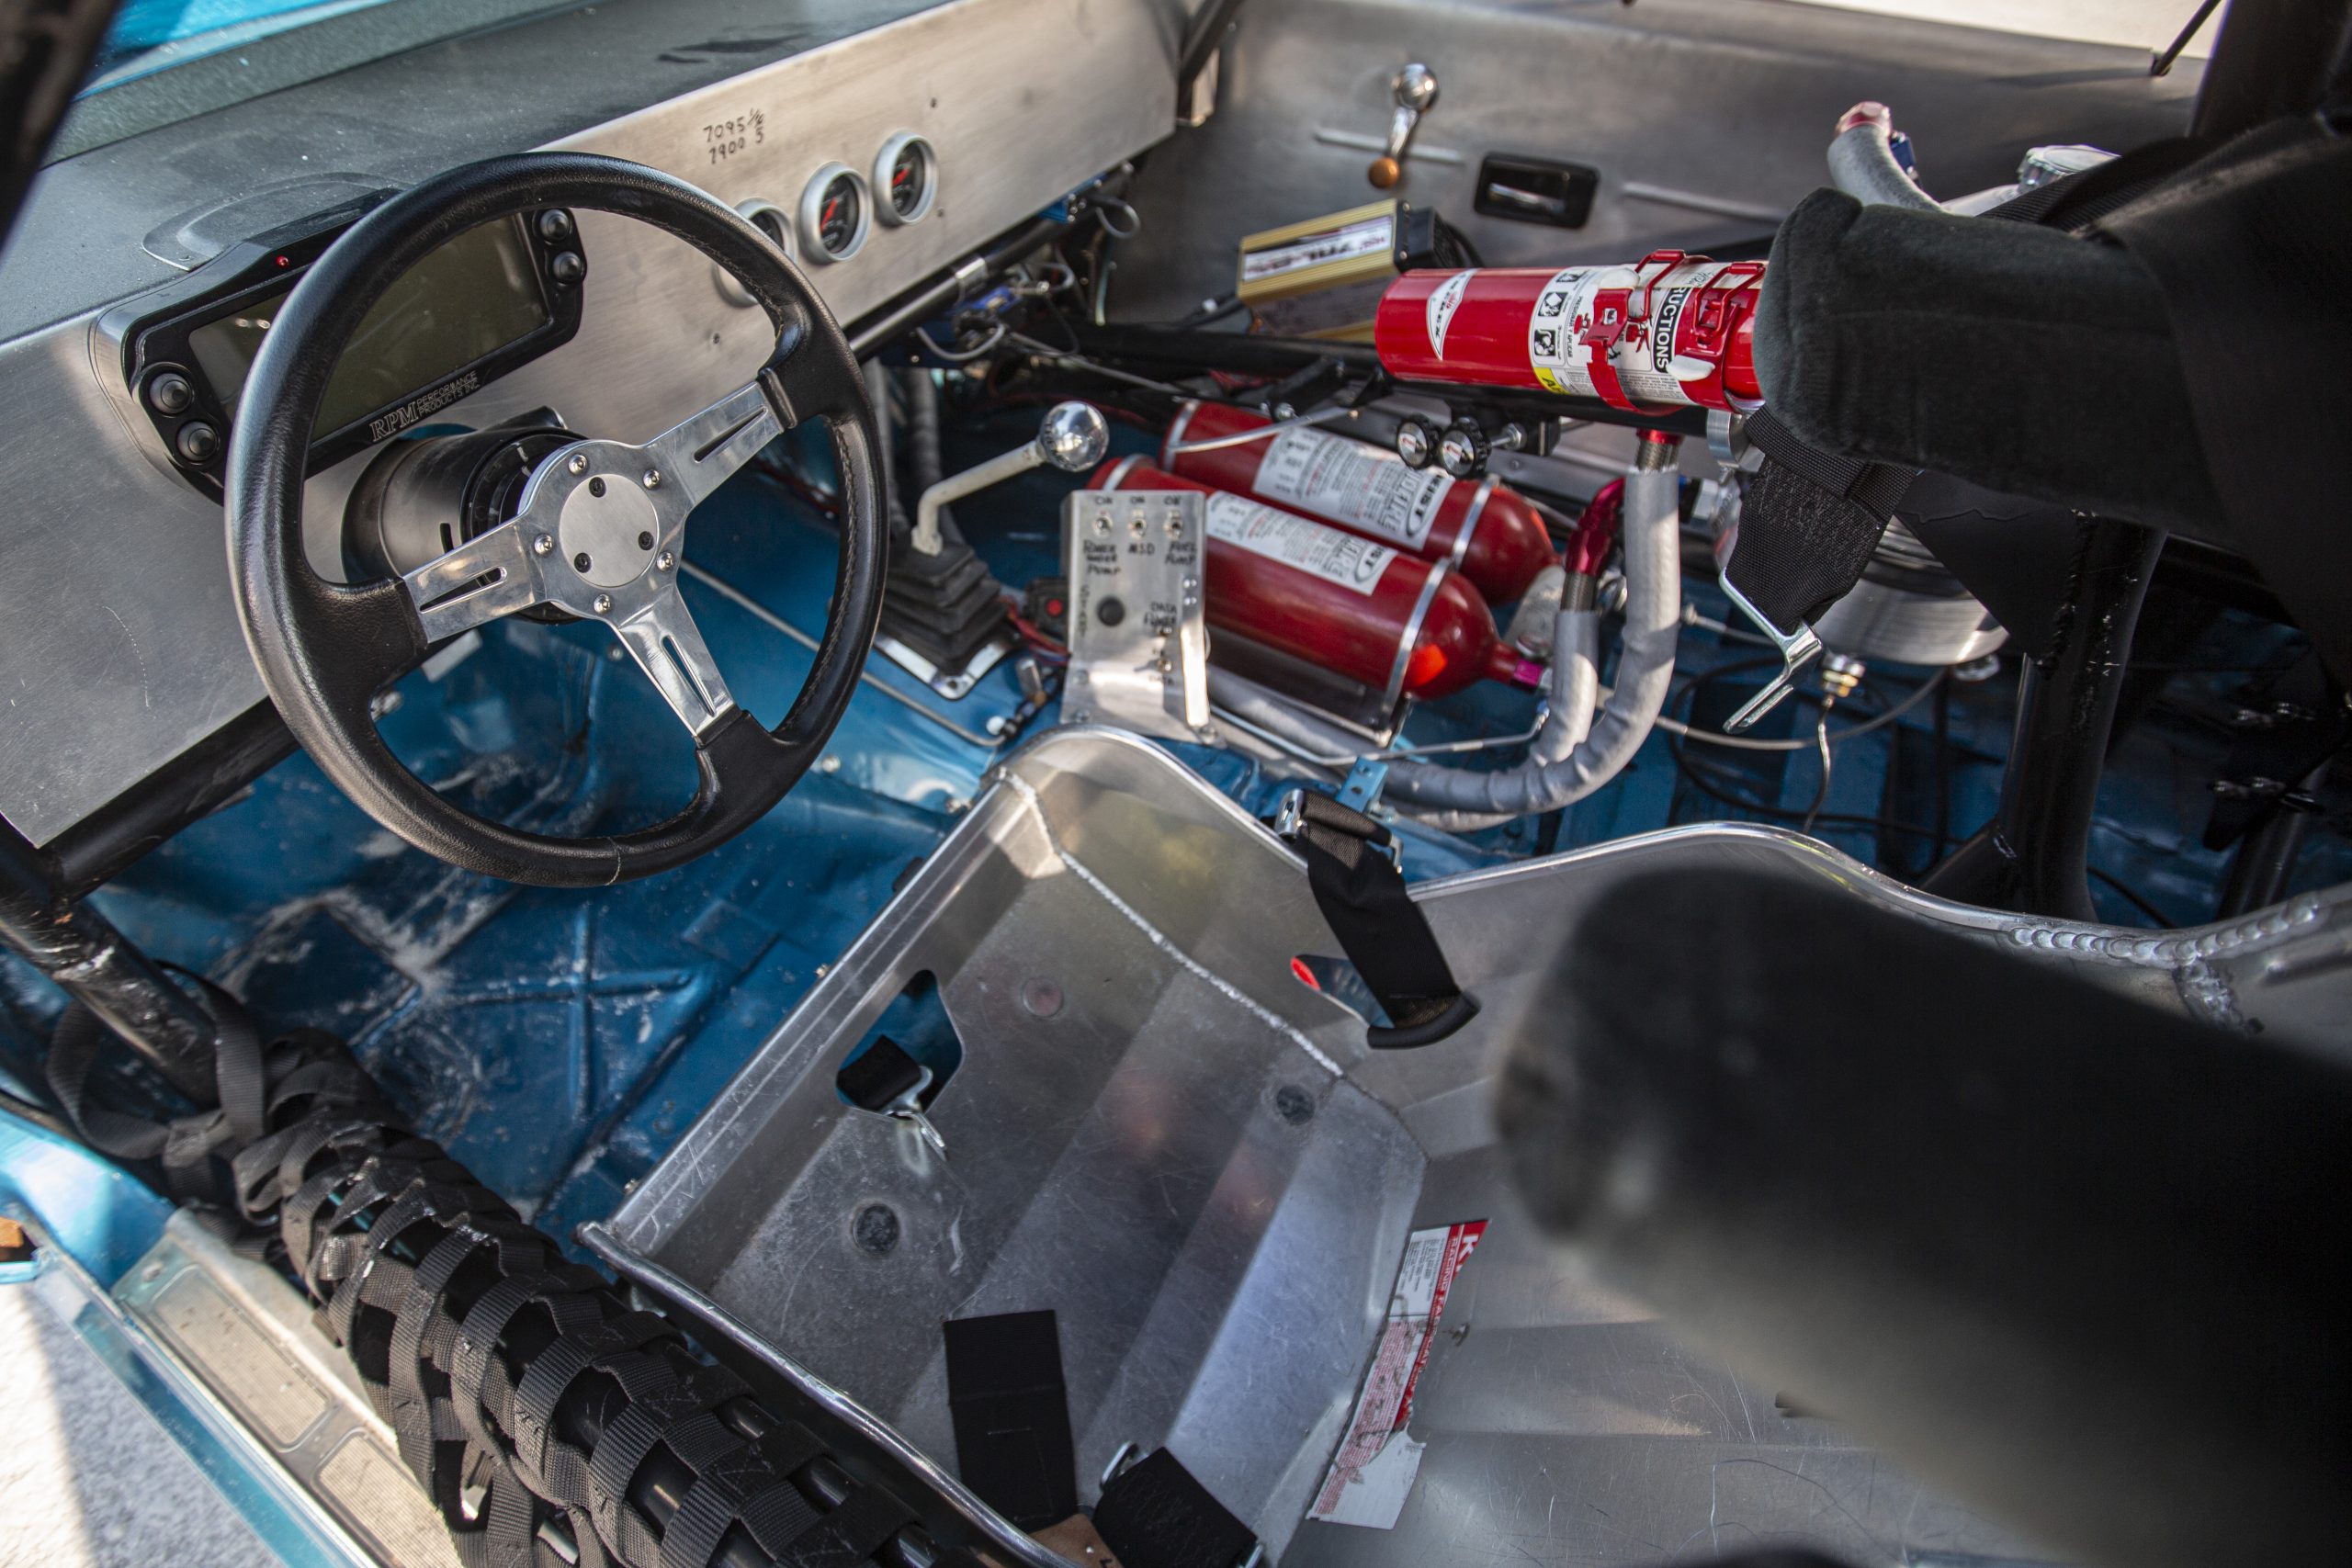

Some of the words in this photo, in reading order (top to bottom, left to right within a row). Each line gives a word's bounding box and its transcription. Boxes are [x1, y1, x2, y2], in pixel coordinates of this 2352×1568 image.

[702, 117, 745, 142] 7095
[1657, 288, 1690, 370] RUCTIONS
[416, 370, 477, 409] PERFORMANCE
[417, 388, 463, 417] PRODUCTS
[369, 401, 418, 442] RPM
